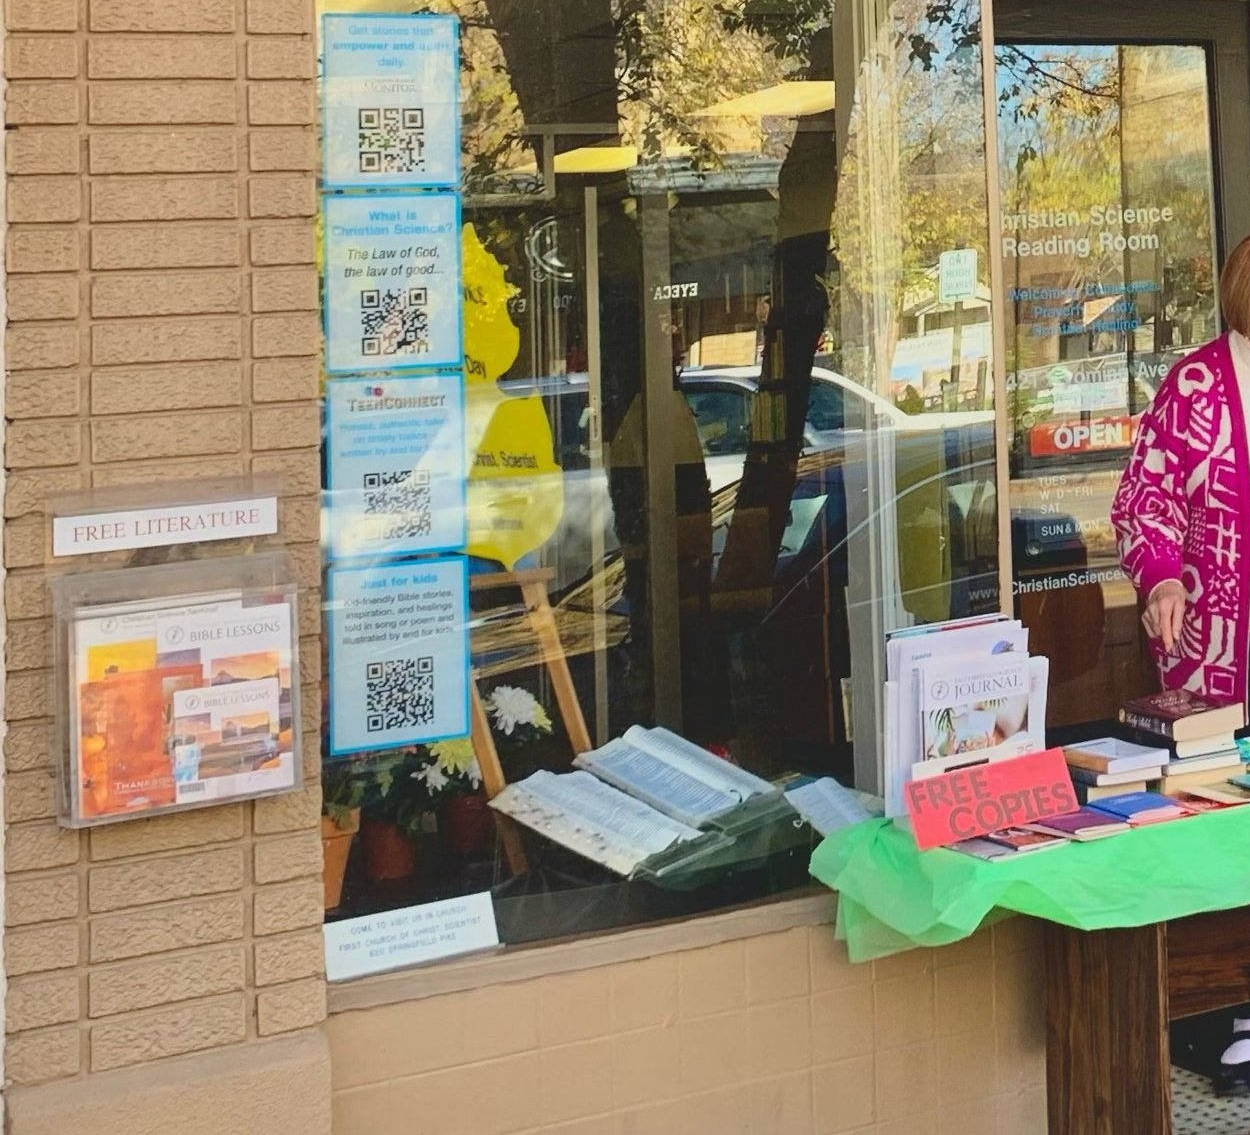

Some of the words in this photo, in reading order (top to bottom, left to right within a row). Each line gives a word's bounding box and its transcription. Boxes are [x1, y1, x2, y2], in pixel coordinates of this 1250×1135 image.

[332, 42, 388, 52] empower
[392, 40, 415, 51] and
[368, 210, 401, 222] What
[406, 210, 417, 220] is
[1000, 210, 1080, 230] hristian
[1090, 204, 1174, 226] Science
[331, 224, 390, 237] Christian
[394, 223, 453, 235] Science?
[348, 248, 369, 260] The
[372, 247, 397, 259] Law
[400, 246, 413, 258] of
[415, 246, 440, 259] God,
[1002, 236, 1090, 258] Reading
[1099, 231, 1160, 252] Room
[344, 267, 367, 278] the
[366, 266, 388, 277] law
[391, 264, 404, 276] of
[1034, 304, 1084, 318] Prayerf
[1006, 371, 1038, 392] 421
[1137, 362, 1169, 379] Ave
[1053, 422, 1124, 450] OPEN
[1038, 475, 1068, 487] TUES
[1039, 489, 1064, 501] WD
[1074, 486, 1094, 498] FRI
[1039, 503, 1060, 515] SAT
[73, 523, 127, 543] FREE
[134, 508, 261, 537] LITERATURE
[1041, 524, 1064, 537] SUN
[1074, 519, 1100, 532] MON
[360, 578, 388, 590] Just
[391, 577, 409, 586] for
[413, 574, 438, 584] kids
[397, 592, 420, 602] Bible
[397, 605, 415, 615] and
[416, 602, 453, 613] healings
[190, 628, 223, 643] BIBLE
[226, 620, 281, 638] LESSONS
[344, 623, 362, 633] told
[363, 621, 373, 630] in
[374, 620, 398, 631] song
[399, 618, 409, 626] or
[411, 617, 435, 627] poem
[437, 614, 455, 623] and
[389, 631, 400, 642] by
[402, 629, 420, 639] and
[421, 627, 434, 637] for
[954, 674, 1024, 701] JOURNAL
[203, 698, 227, 708] BIBLE
[230, 691, 270, 706] LESSONS
[908, 769, 992, 814] FREE
[949, 781, 1074, 839] COPIES
[350, 925, 373, 935] COME
[376, 922, 387, 930] TO
[435, 906, 466, 918] CHURCH
[339, 942, 361, 952] FIRST
[365, 935, 396, 948] CHURCH
[400, 931, 409, 940] OF
